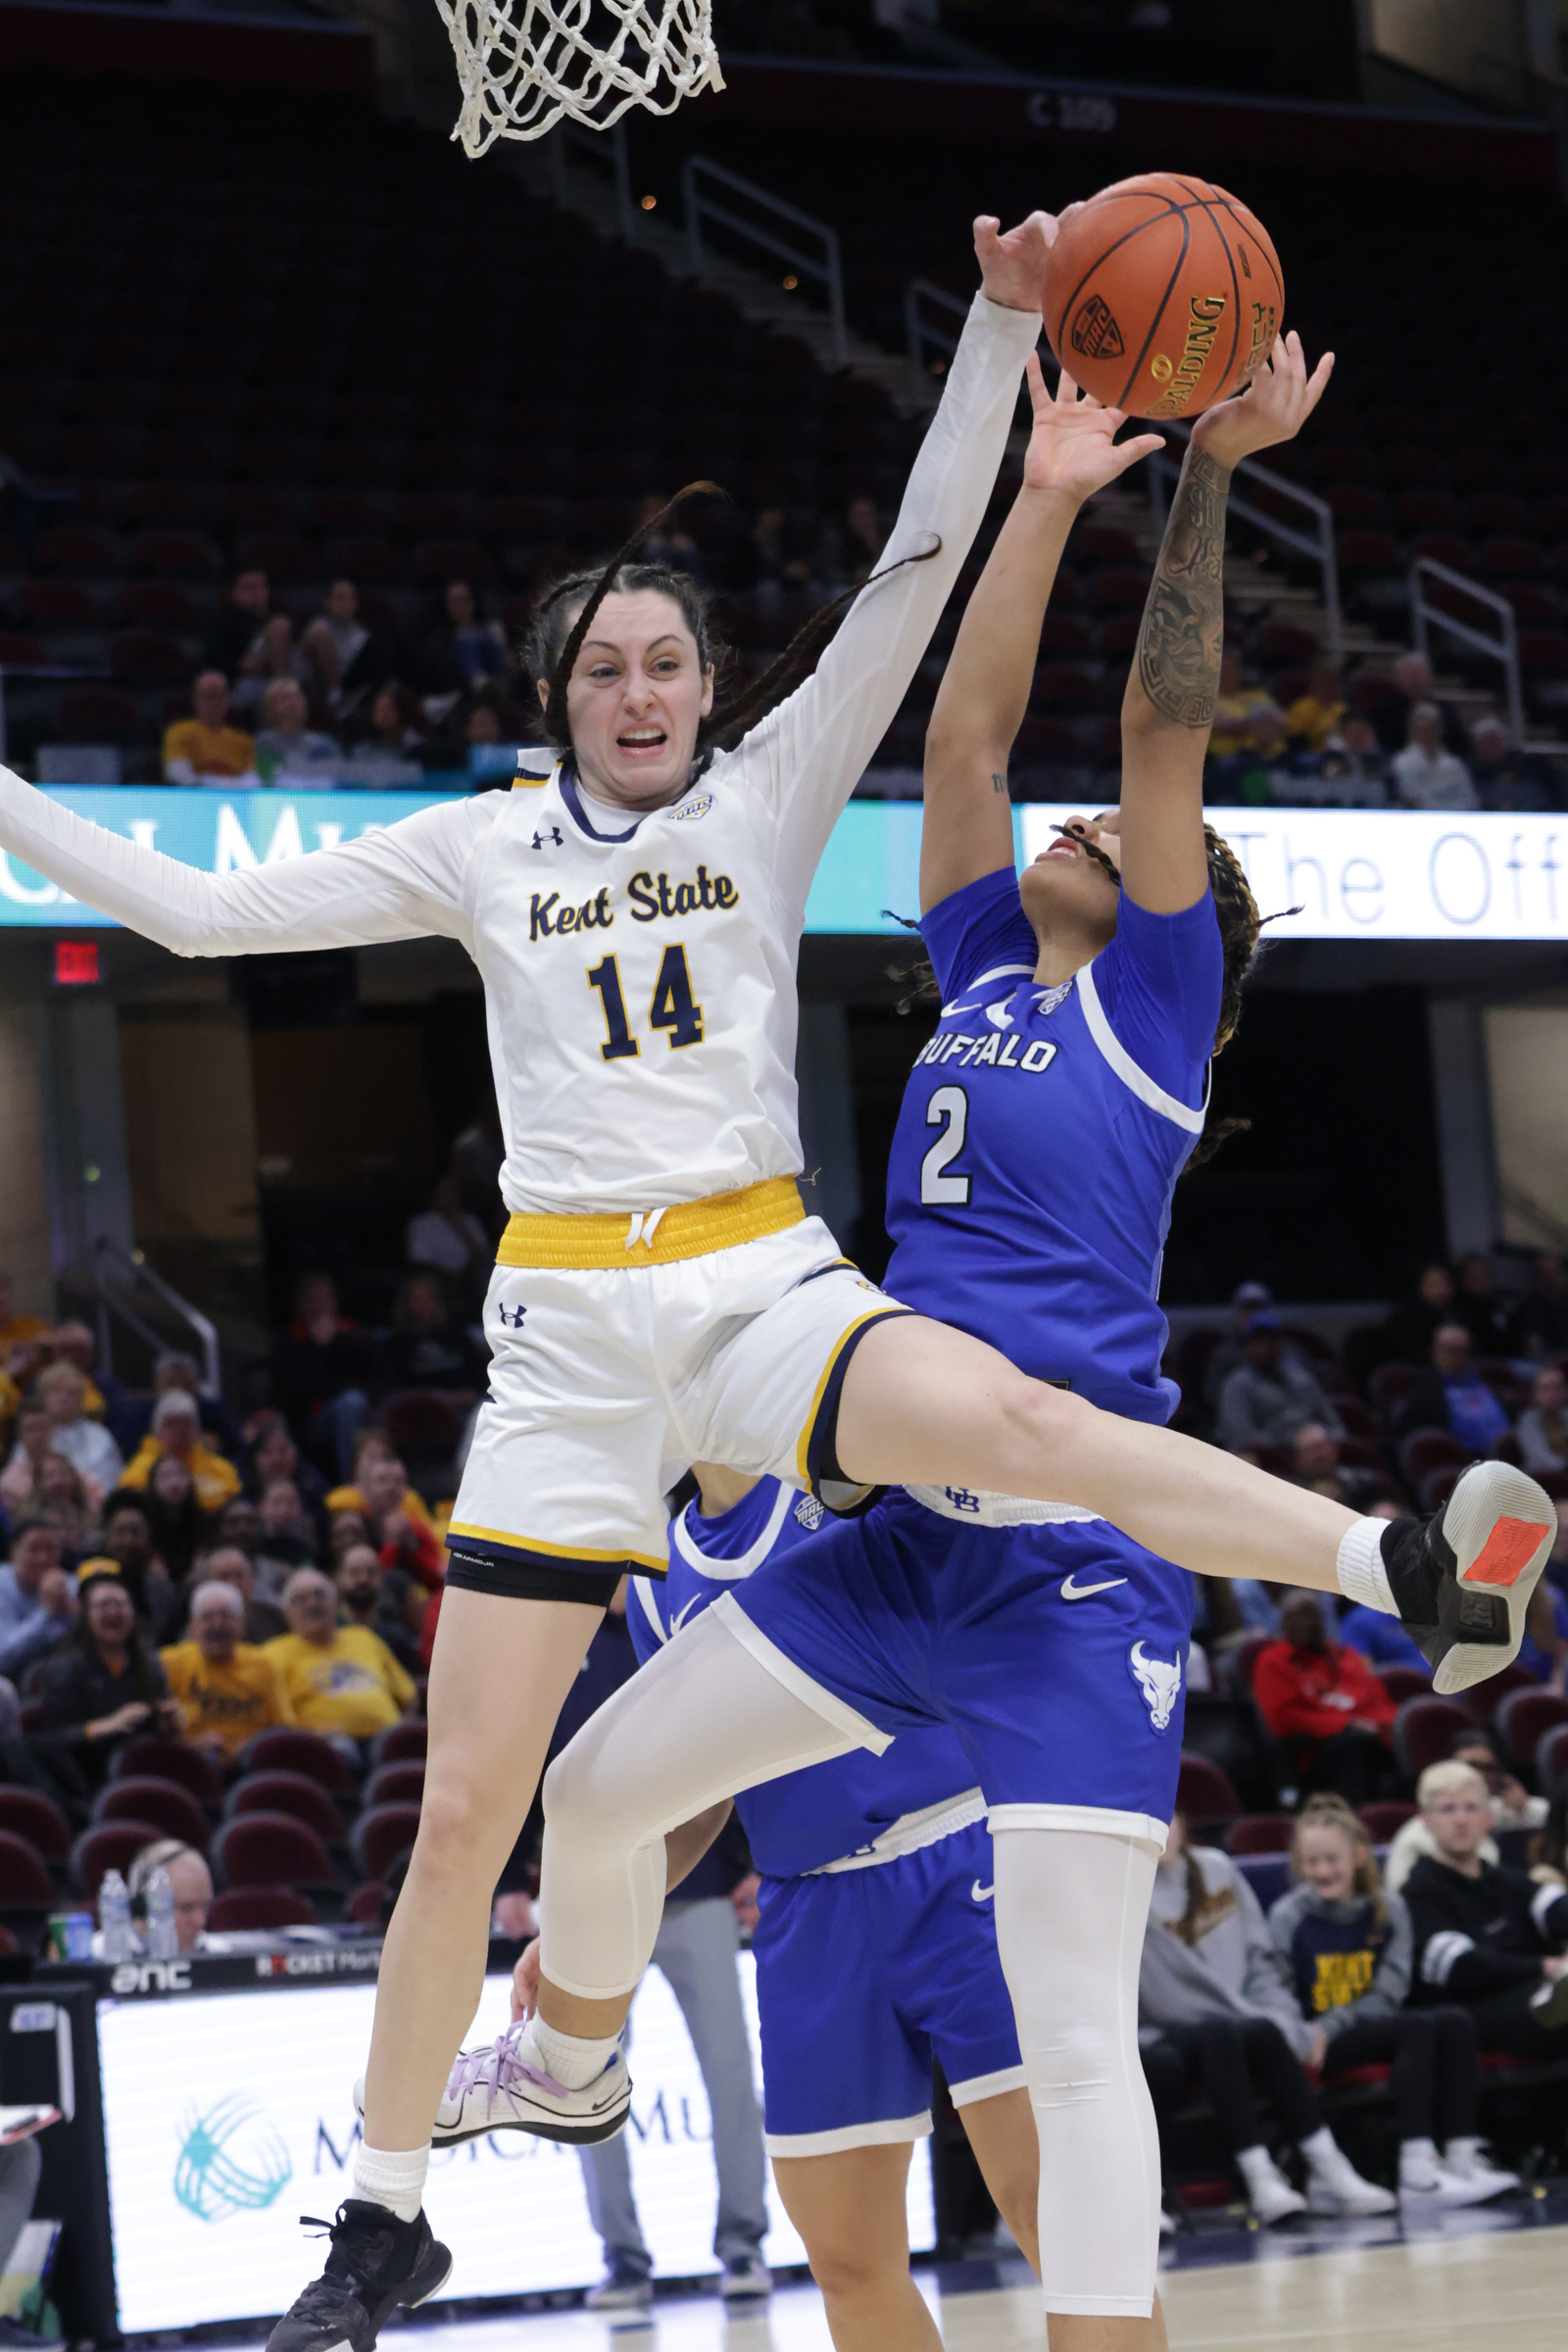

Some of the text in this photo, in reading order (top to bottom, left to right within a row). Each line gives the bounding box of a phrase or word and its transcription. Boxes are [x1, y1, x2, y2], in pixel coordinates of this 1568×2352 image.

[627, 863, 740, 922] State
[586, 942, 706, 1063] 14
[919, 1084, 972, 1207] 2
